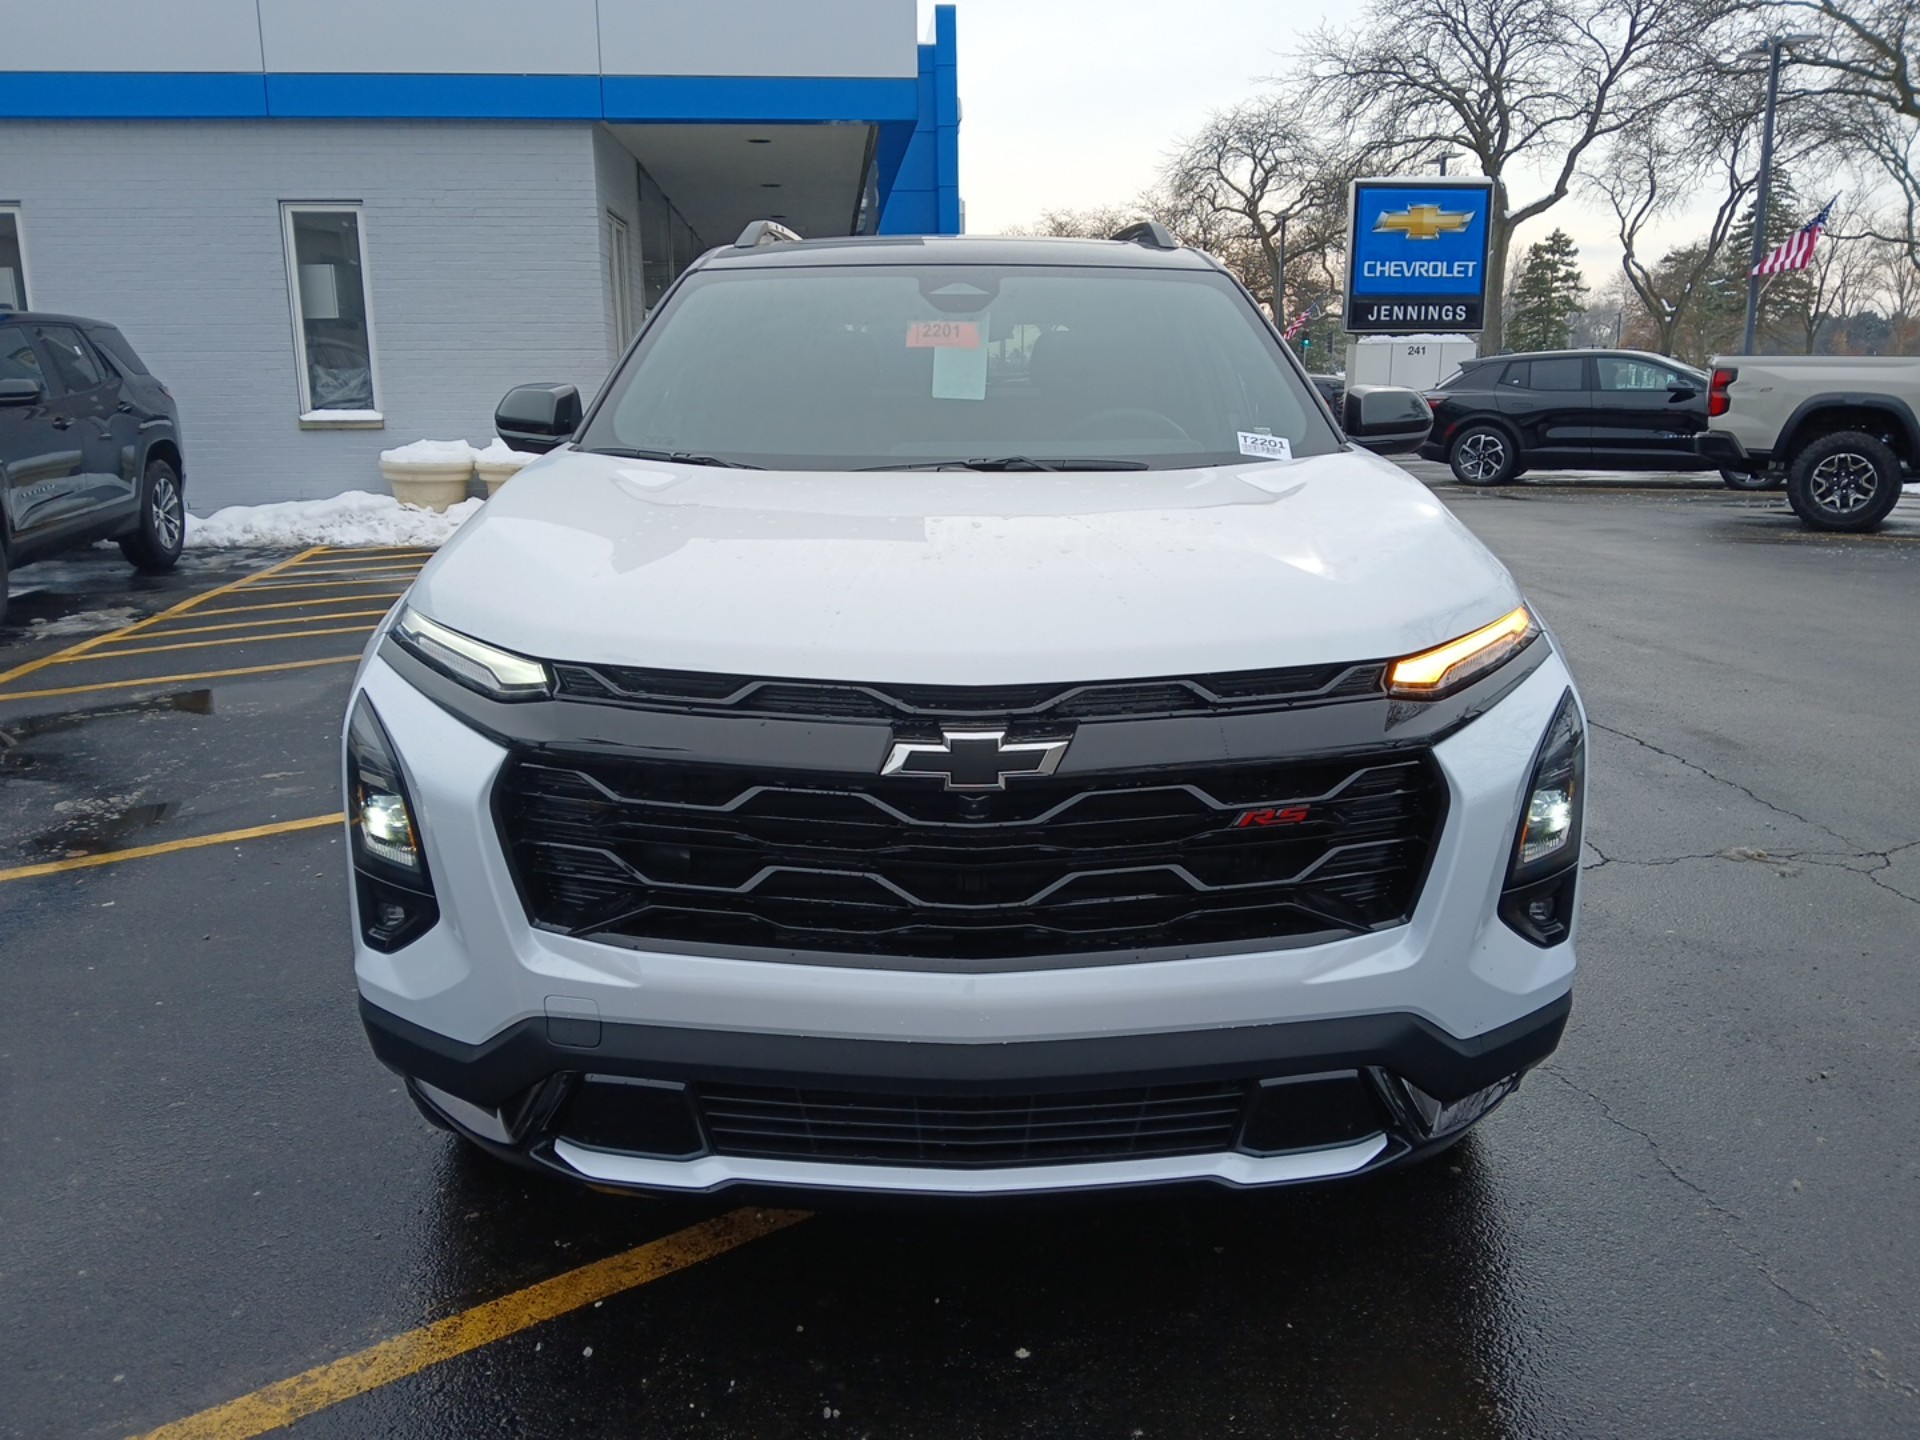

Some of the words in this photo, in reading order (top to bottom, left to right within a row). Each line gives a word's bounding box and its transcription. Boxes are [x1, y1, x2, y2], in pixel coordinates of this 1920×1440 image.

[1363, 261, 1477, 277] CHEVROLET
[1367, 305, 1467, 321] JENNINGS
[922, 323, 960, 337] 2201
[1407, 346, 1426, 355] 241
[1241, 435, 1286, 449] T2201
[1234, 804, 1310, 828] RS
